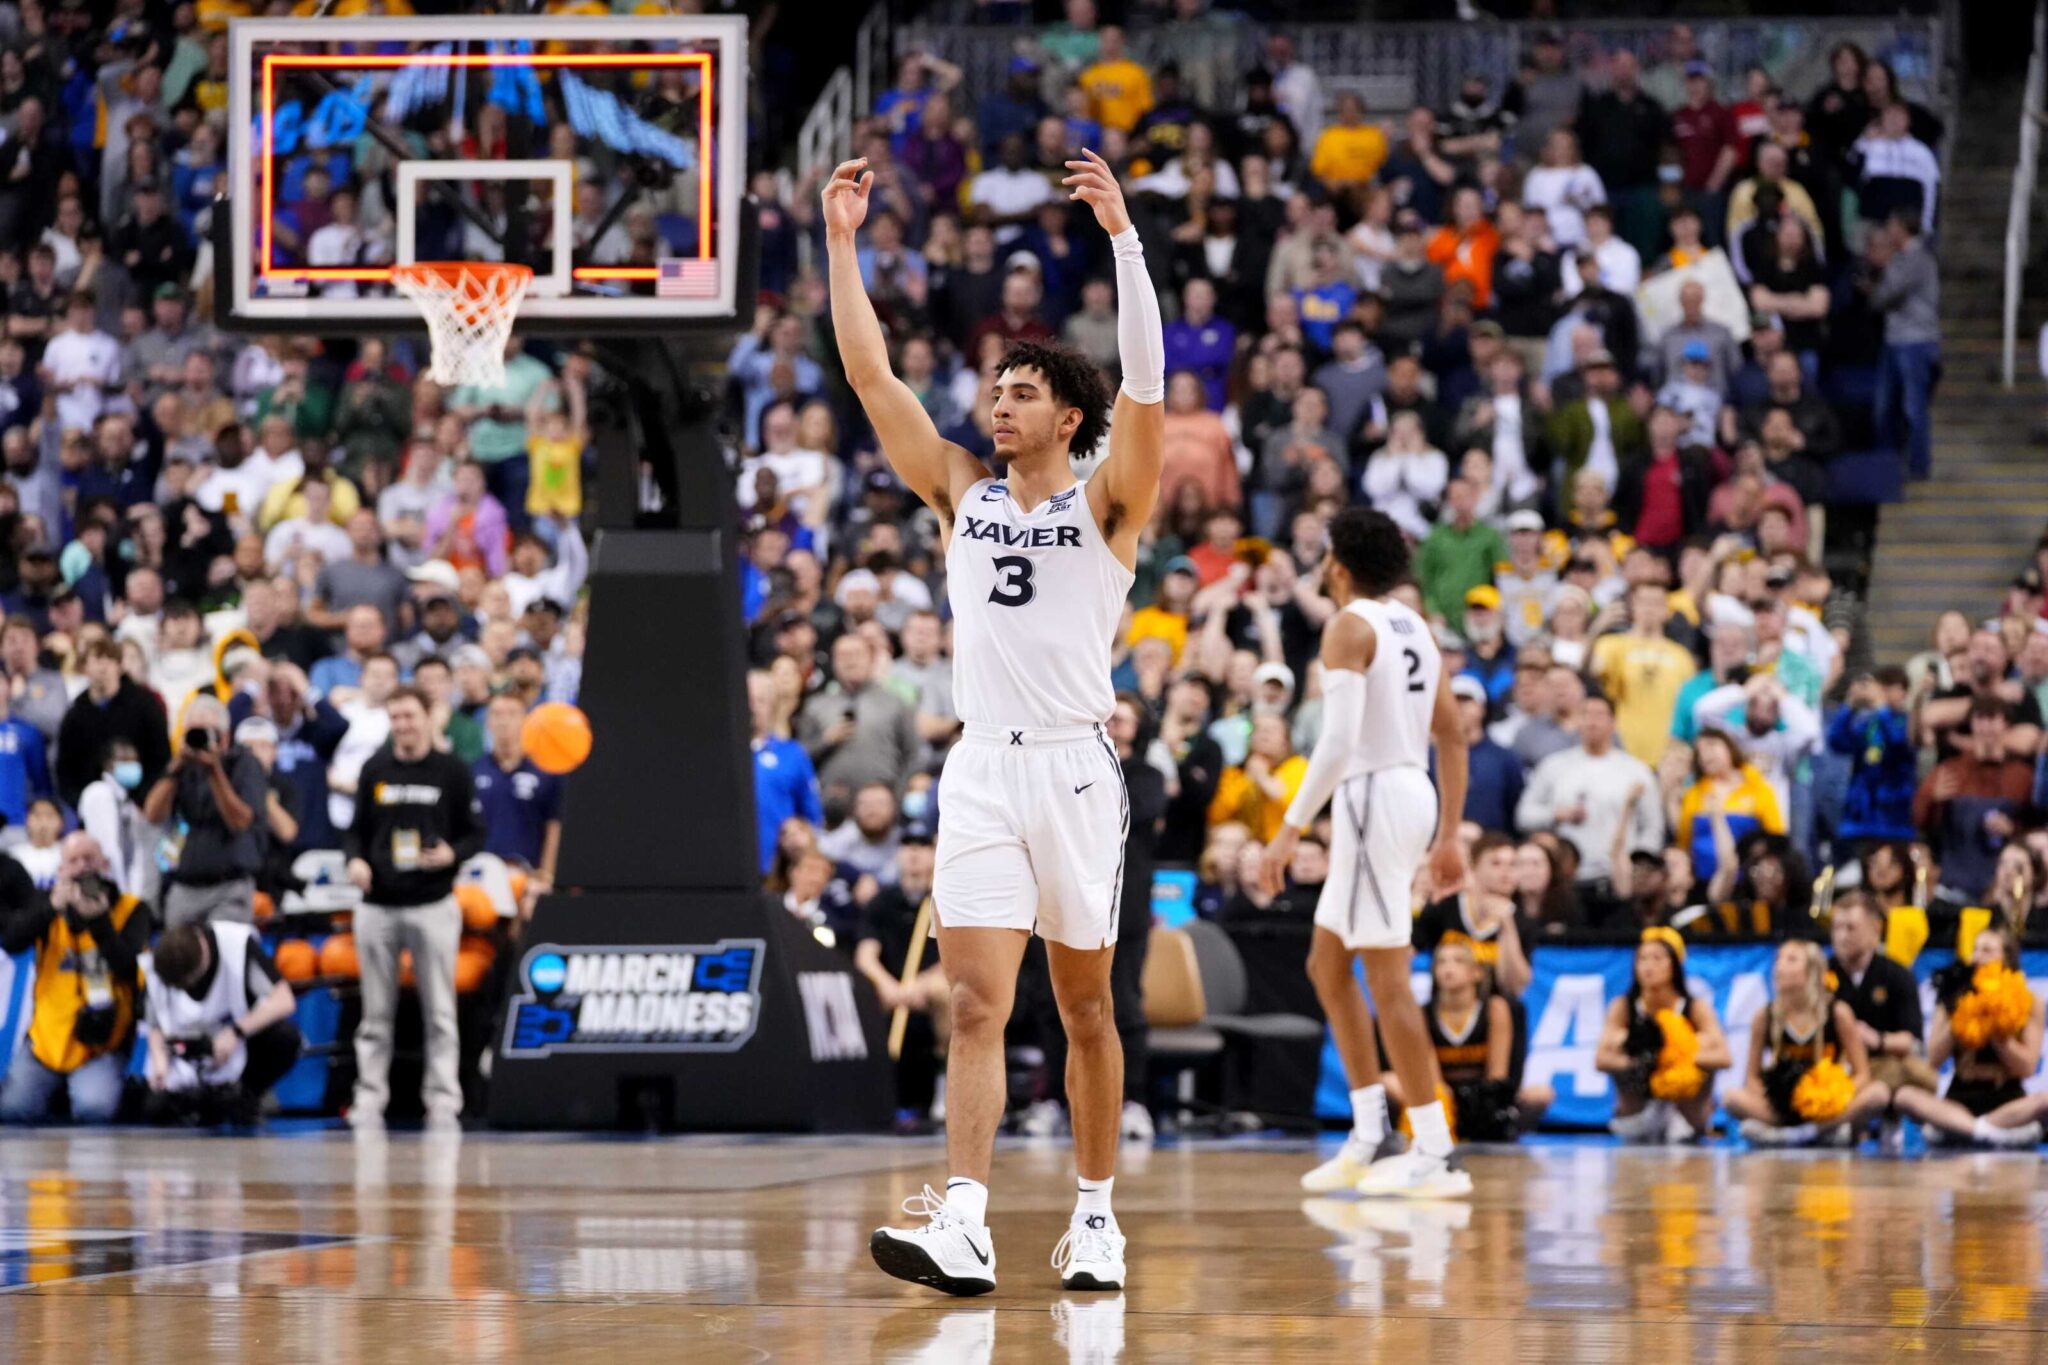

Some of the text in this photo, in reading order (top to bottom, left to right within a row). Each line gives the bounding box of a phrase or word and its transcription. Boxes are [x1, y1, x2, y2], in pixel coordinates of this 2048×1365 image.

[1046, 503, 1072, 515] EAST
[960, 515, 1083, 549] XAVIER
[988, 555, 1036, 607] 3
[1403, 648, 1424, 692] 2
[1010, 730, 1024, 746] X
[563, 953, 695, 994] MARCH
[577, 992, 752, 1036] MADNESS
